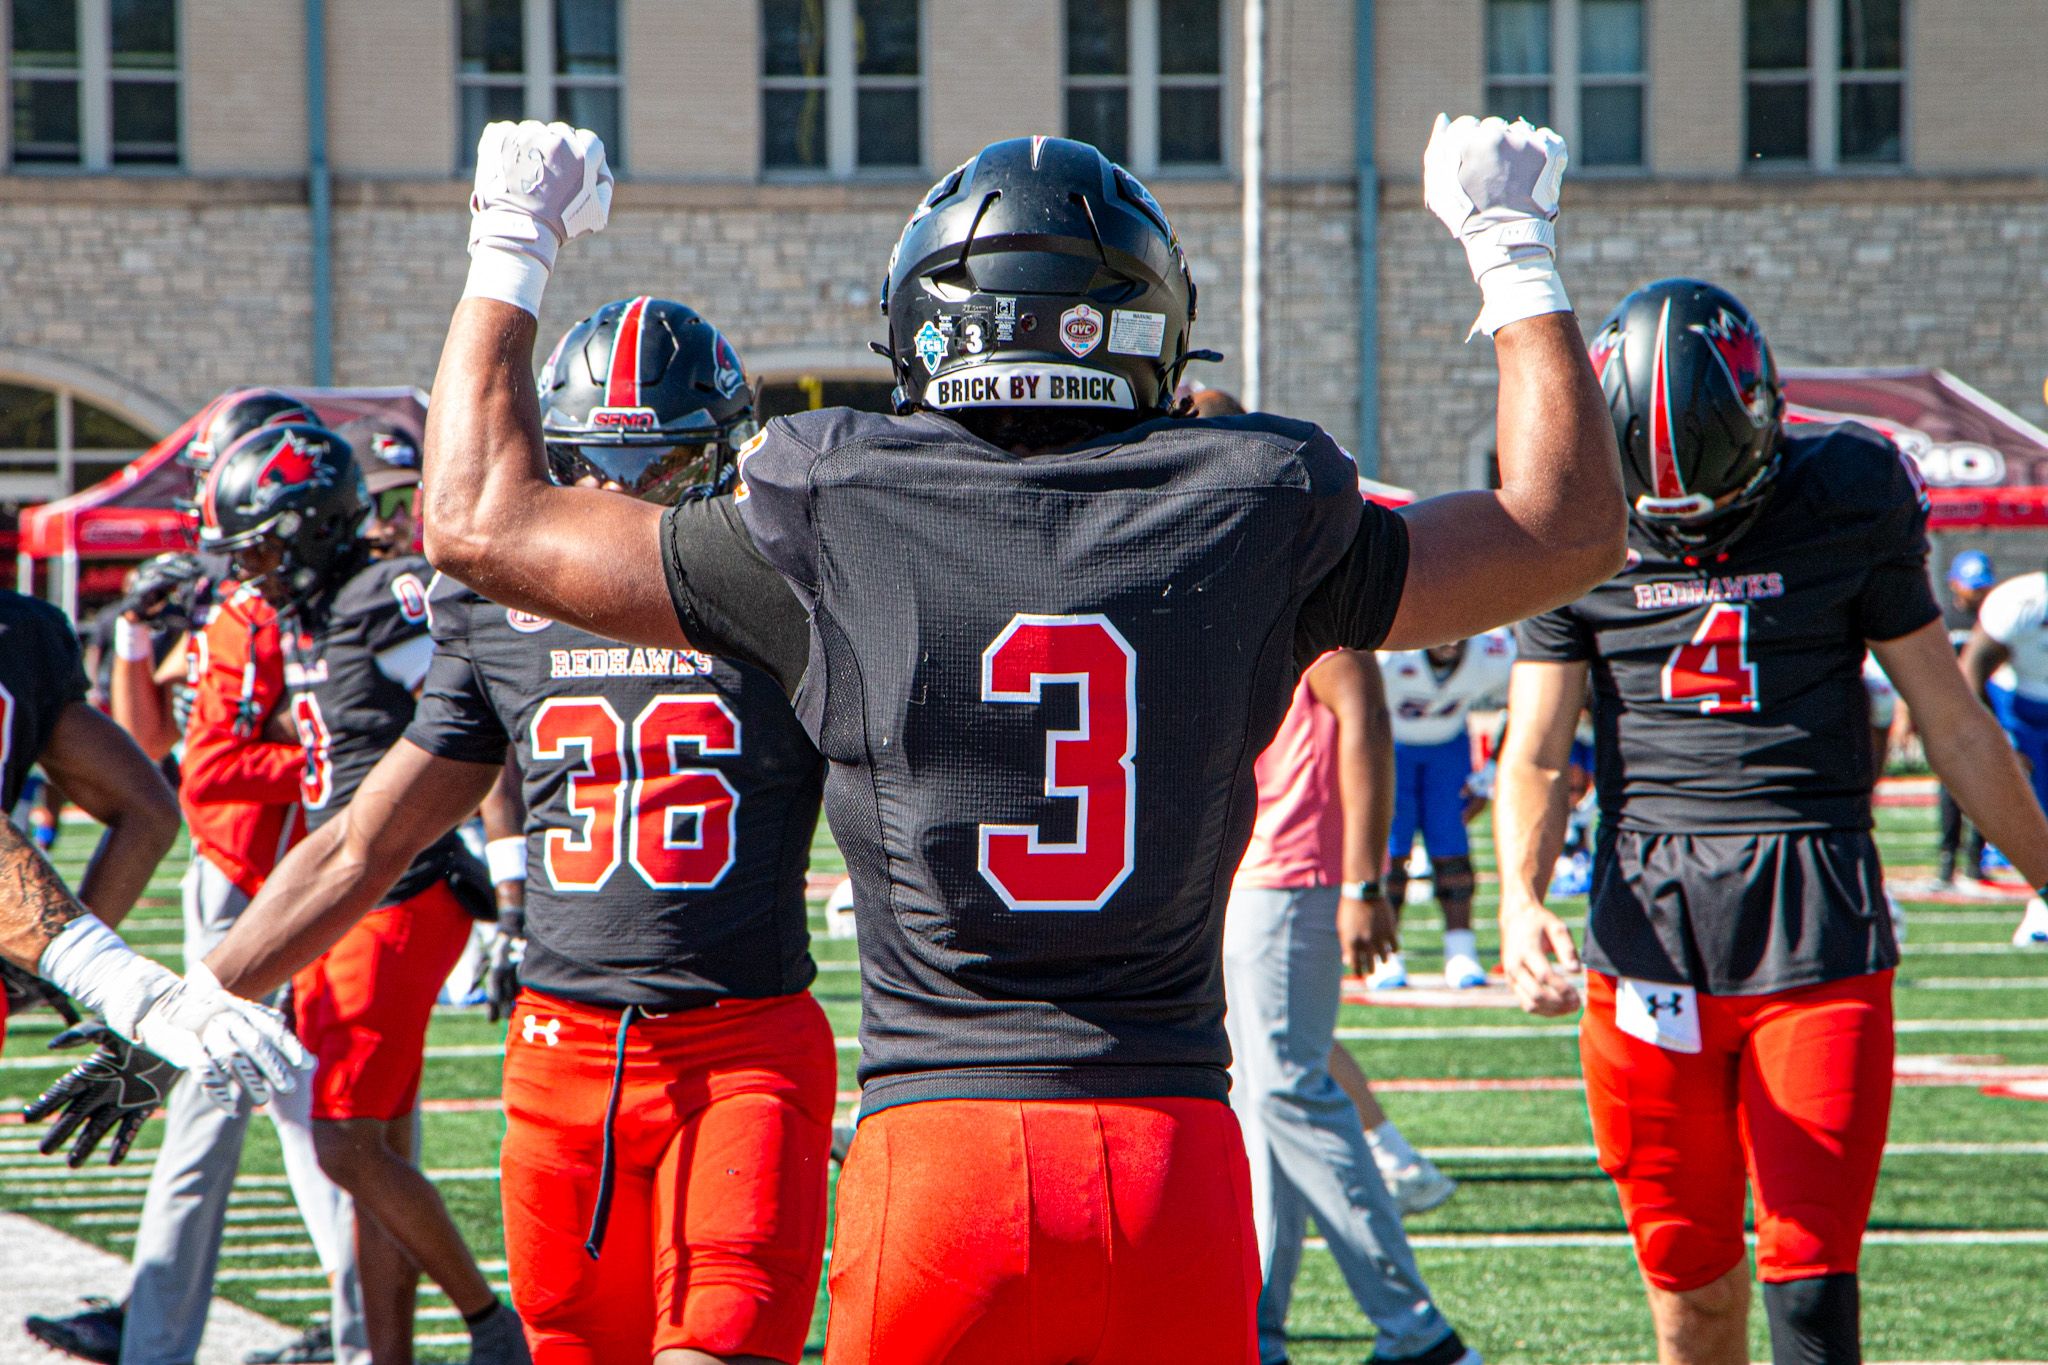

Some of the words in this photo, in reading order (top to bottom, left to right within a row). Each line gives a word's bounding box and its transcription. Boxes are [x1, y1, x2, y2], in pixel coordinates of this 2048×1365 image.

[965, 323, 983, 354] 3
[1071, 324, 1092, 334] OVC
[938, 376, 1001, 405] BRICK
[1010, 375, 1040, 400] BY
[1050, 375, 1117, 402] BRICK
[594, 413, 654, 429] SEMO
[1634, 571, 1784, 610] REDHAWKS
[550, 647, 713, 679] REDHAWKS
[1661, 601, 1760, 714] 4
[977, 612, 1137, 911] 3
[529, 693, 741, 892] 36
